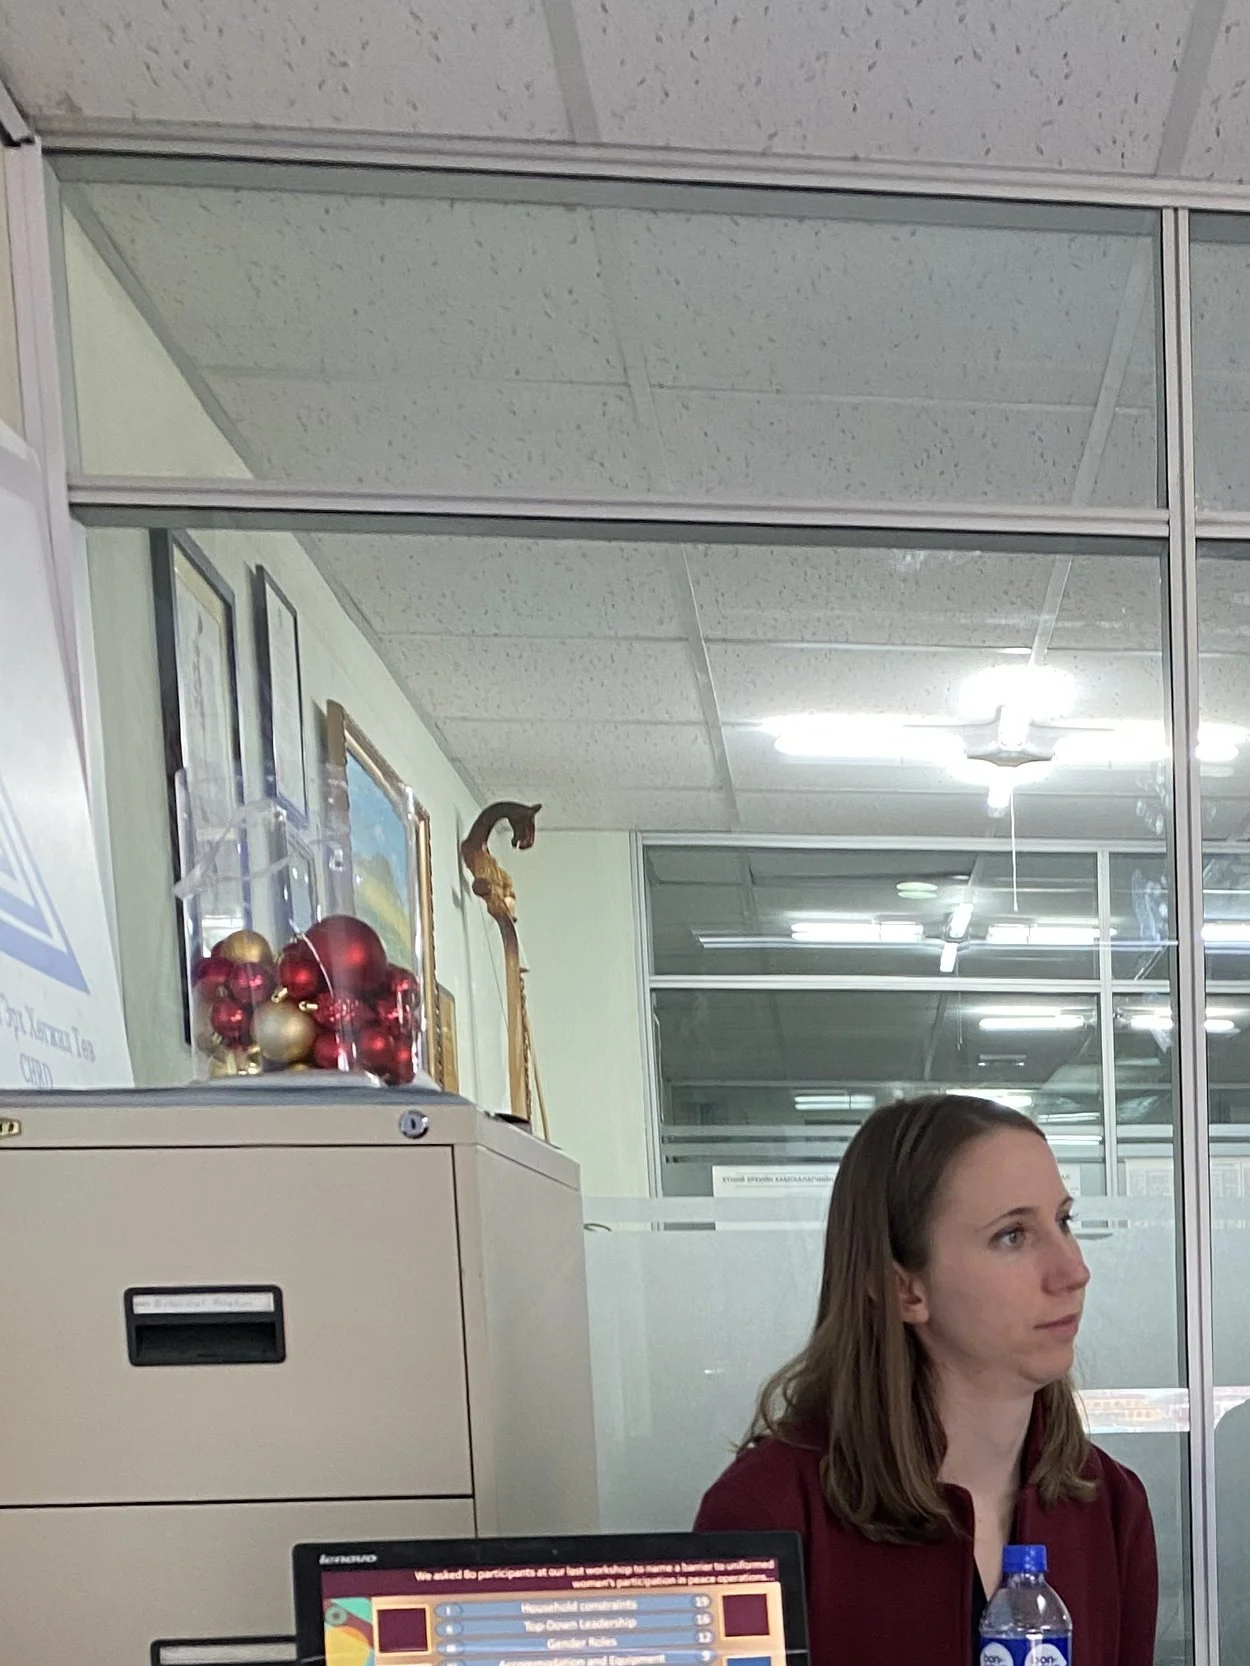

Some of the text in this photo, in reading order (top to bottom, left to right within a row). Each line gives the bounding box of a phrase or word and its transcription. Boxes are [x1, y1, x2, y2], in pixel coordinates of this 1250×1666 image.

[414, 1570, 432, 1582] We
[433, 1568, 462, 1581] asked
[477, 1566, 535, 1585] participants
[536, 1568, 548, 1577] at
[549, 1567, 565, 1577] our
[566, 1565, 584, 1576] last
[584, 1564, 633, 1578] workshop
[633, 1564, 645, 1574] to
[645, 1564, 673, 1574] name
[674, 1565, 681, 1573] a
[681, 1561, 713, 1573] barrier
[714, 1562, 725, 1571] to
[726, 1559, 775, 1571] uniformed
[616, 1575, 676, 1589] participation
[677, 1575, 686, 1584] in
[687, 1575, 716, 1586] peace
[520, 1601, 578, 1614] Household
[579, 1599, 638, 1611] constraints
[578, 1617, 637, 1631] Leadership
[547, 1638, 587, 1650] Gender
[588, 1637, 618, 1648] Roles
[698, 1632, 712, 1643] 12
[587, 1656, 608, 1666] and
[608, 1653, 666, 1666] Equipment
